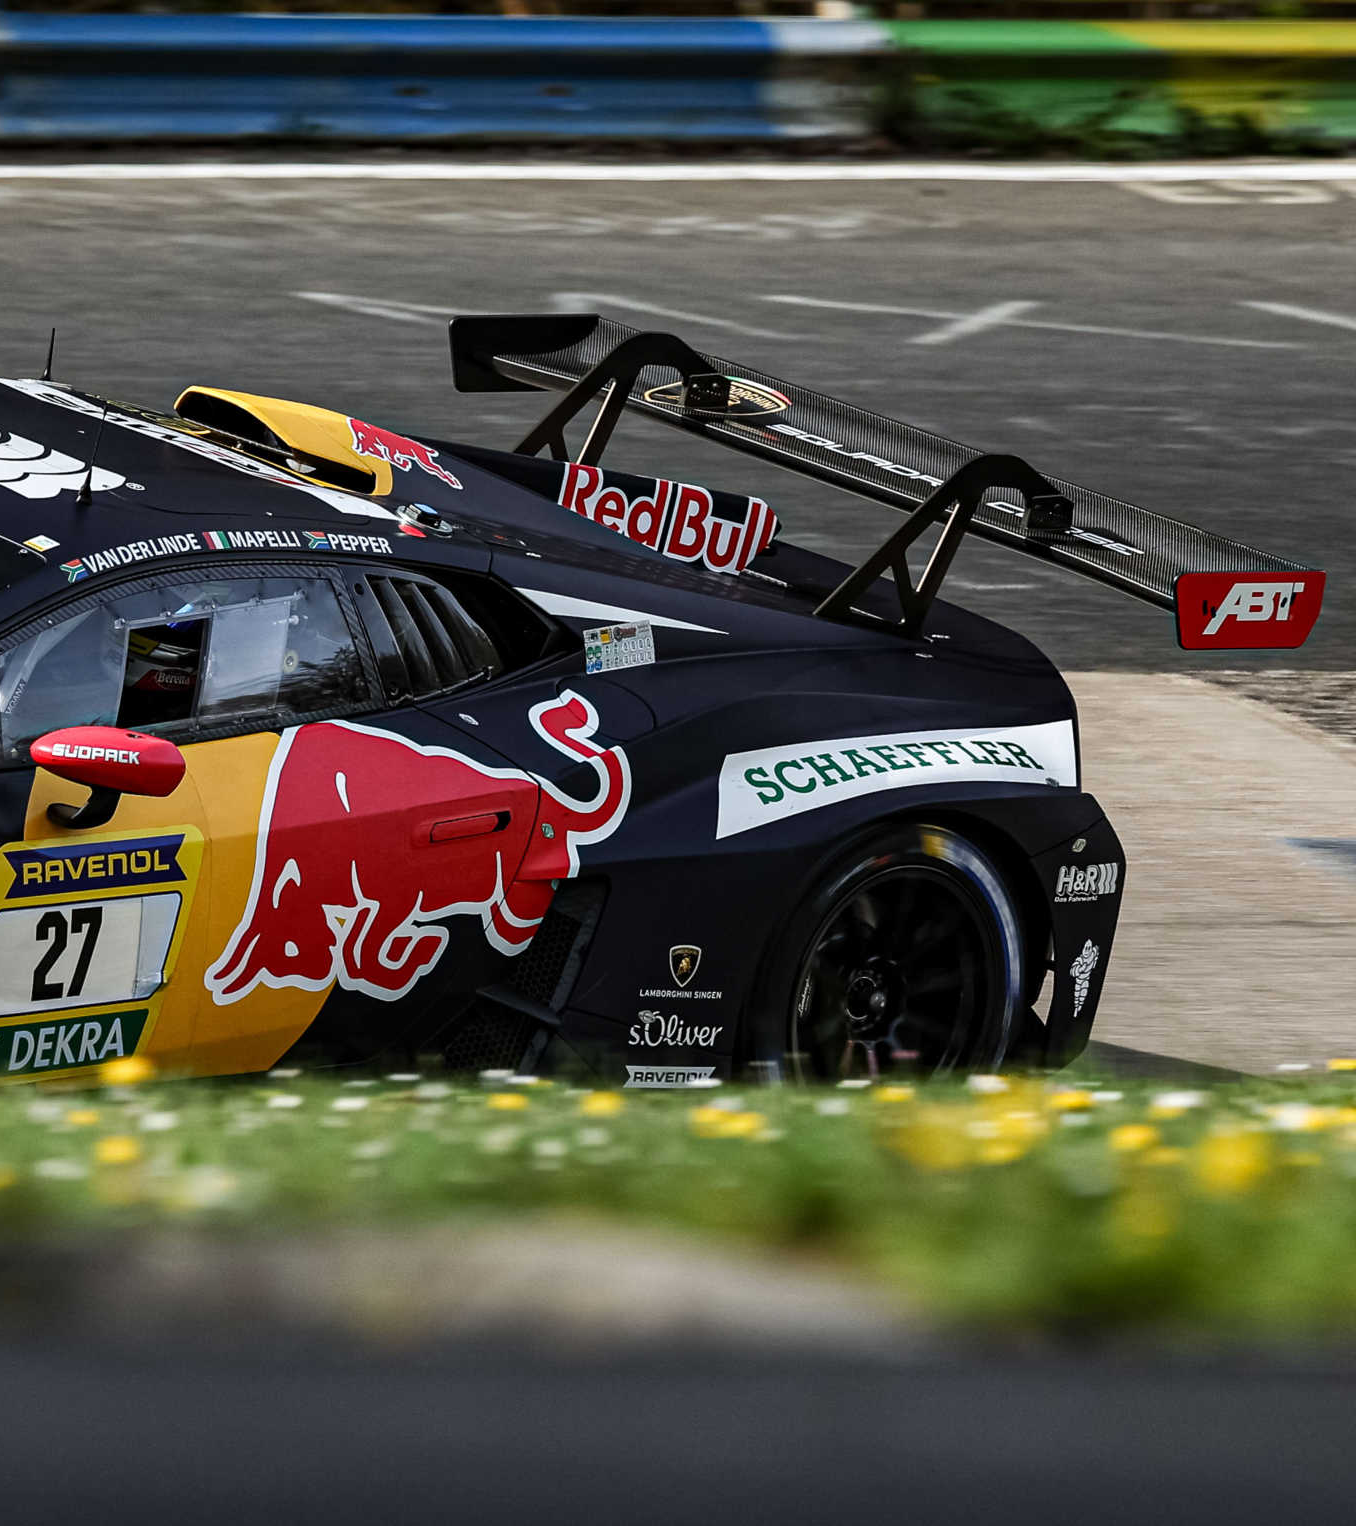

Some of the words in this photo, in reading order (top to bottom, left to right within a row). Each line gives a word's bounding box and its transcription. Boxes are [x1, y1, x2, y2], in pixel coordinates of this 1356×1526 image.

[765, 424, 945, 488] SQUADR
[228, 530, 301, 548] MAPELLI
[327, 533, 393, 554] PEPPER
[1202, 582, 1305, 635] ABT
[743, 740, 1045, 806] SCHAEFFLER
[23, 848, 171, 887] RAVENOL
[31, 906, 103, 1003] 27
[639, 989, 693, 998] LAMBORGHINI
[694, 991, 723, 999] SINGEN
[8, 1017, 124, 1071] DEKRA
[628, 1009, 724, 1047] s.Oliver
